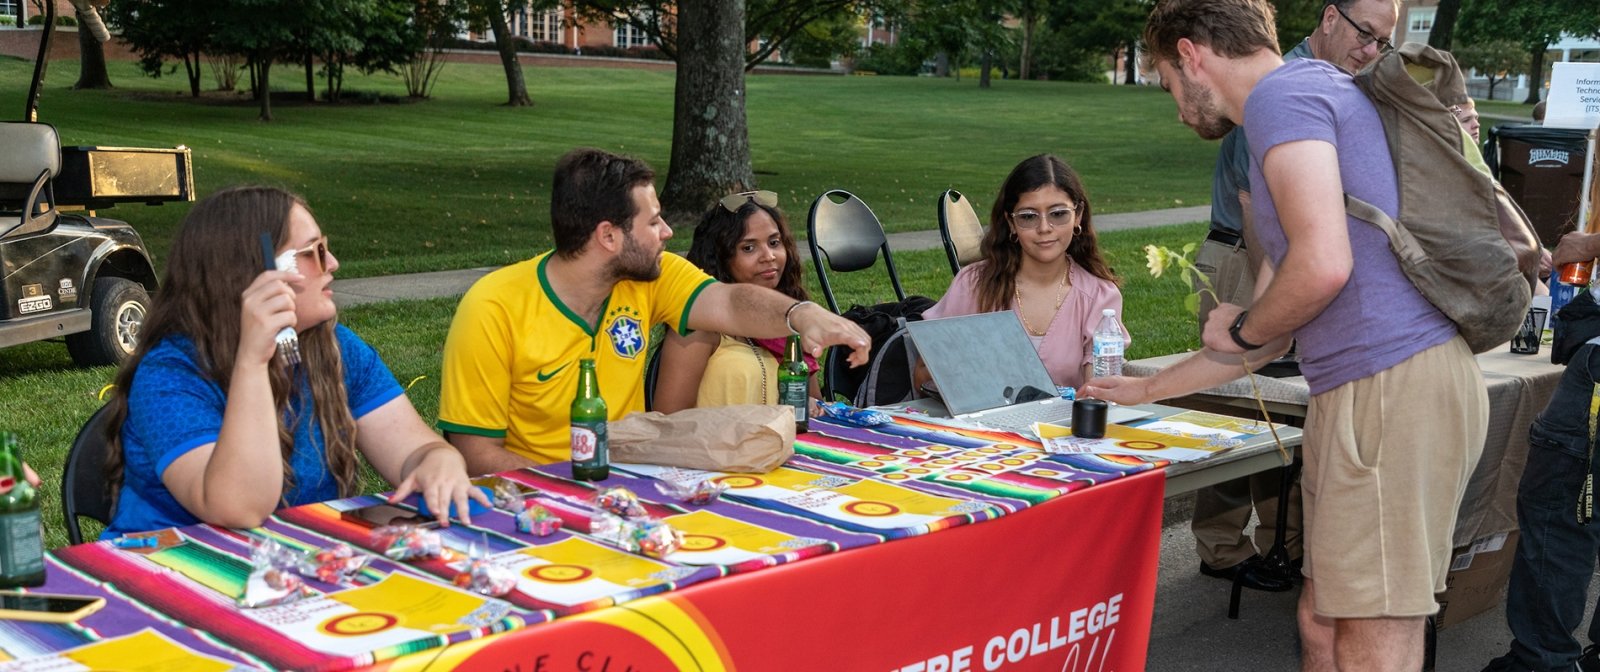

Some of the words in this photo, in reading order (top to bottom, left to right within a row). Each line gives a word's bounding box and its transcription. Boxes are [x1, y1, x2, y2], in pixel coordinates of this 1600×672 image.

[1585, 104, 1600, 113] (ITS
[28, 286, 37, 295] 3
[982, 592, 1123, 672] COLLEGE
